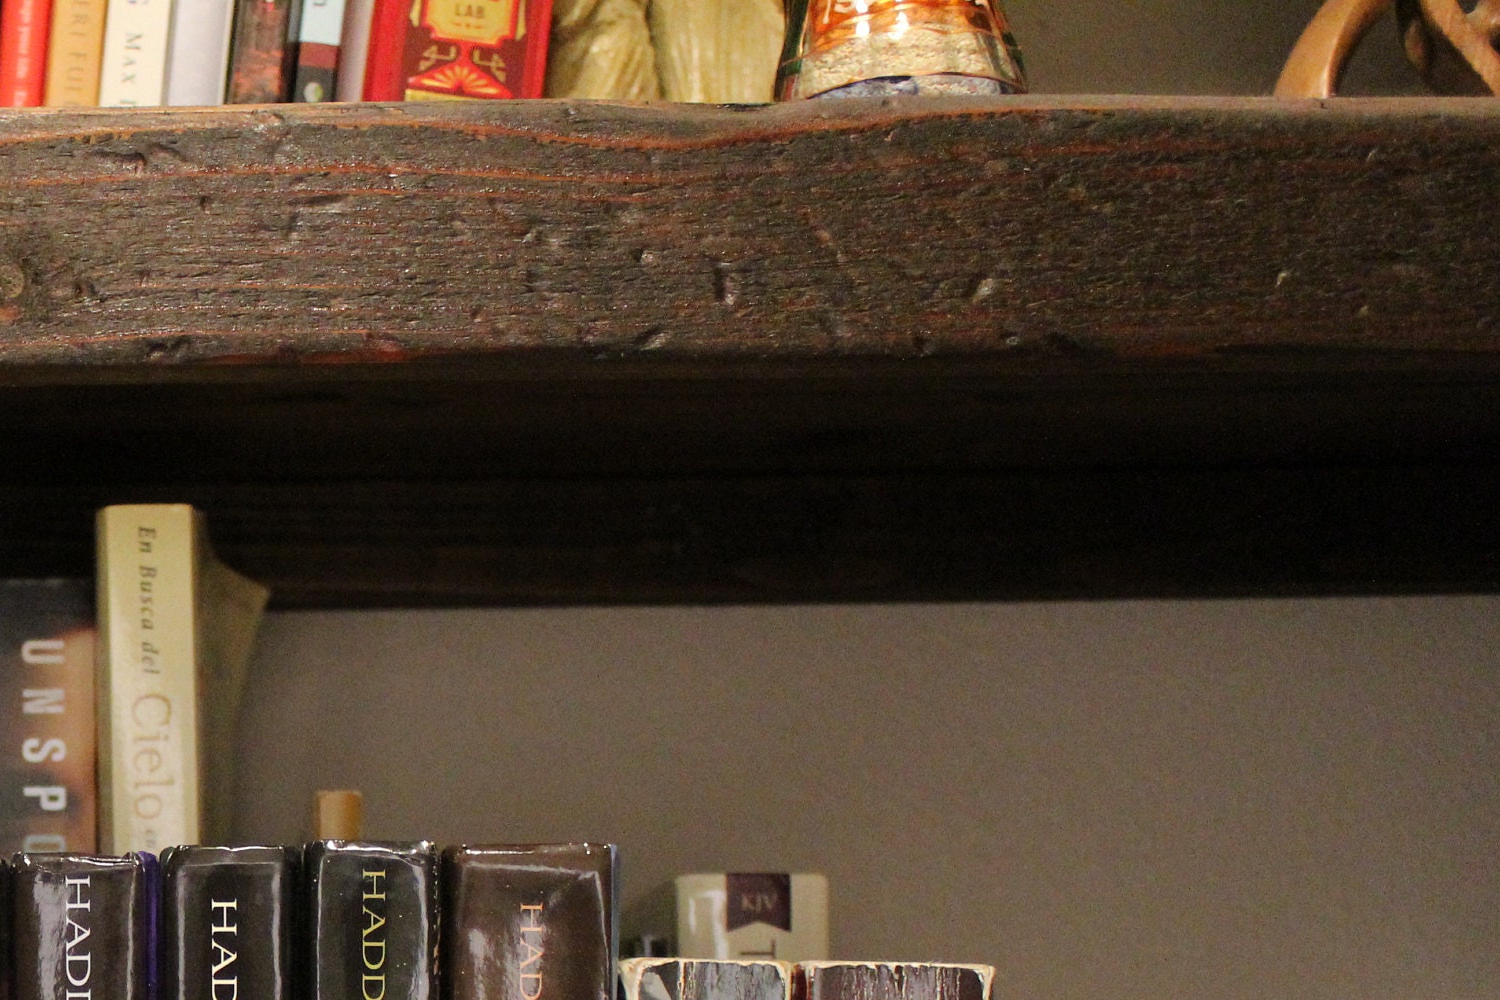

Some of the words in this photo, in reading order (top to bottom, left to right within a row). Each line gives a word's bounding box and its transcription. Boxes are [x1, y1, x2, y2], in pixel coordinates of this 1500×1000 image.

[454, 4, 486, 19] LAB
[138, 526, 157, 553] En
[139, 565, 158, 630] Busca
[141, 642, 160, 675] del
[132, 693, 176, 820] Cielo
